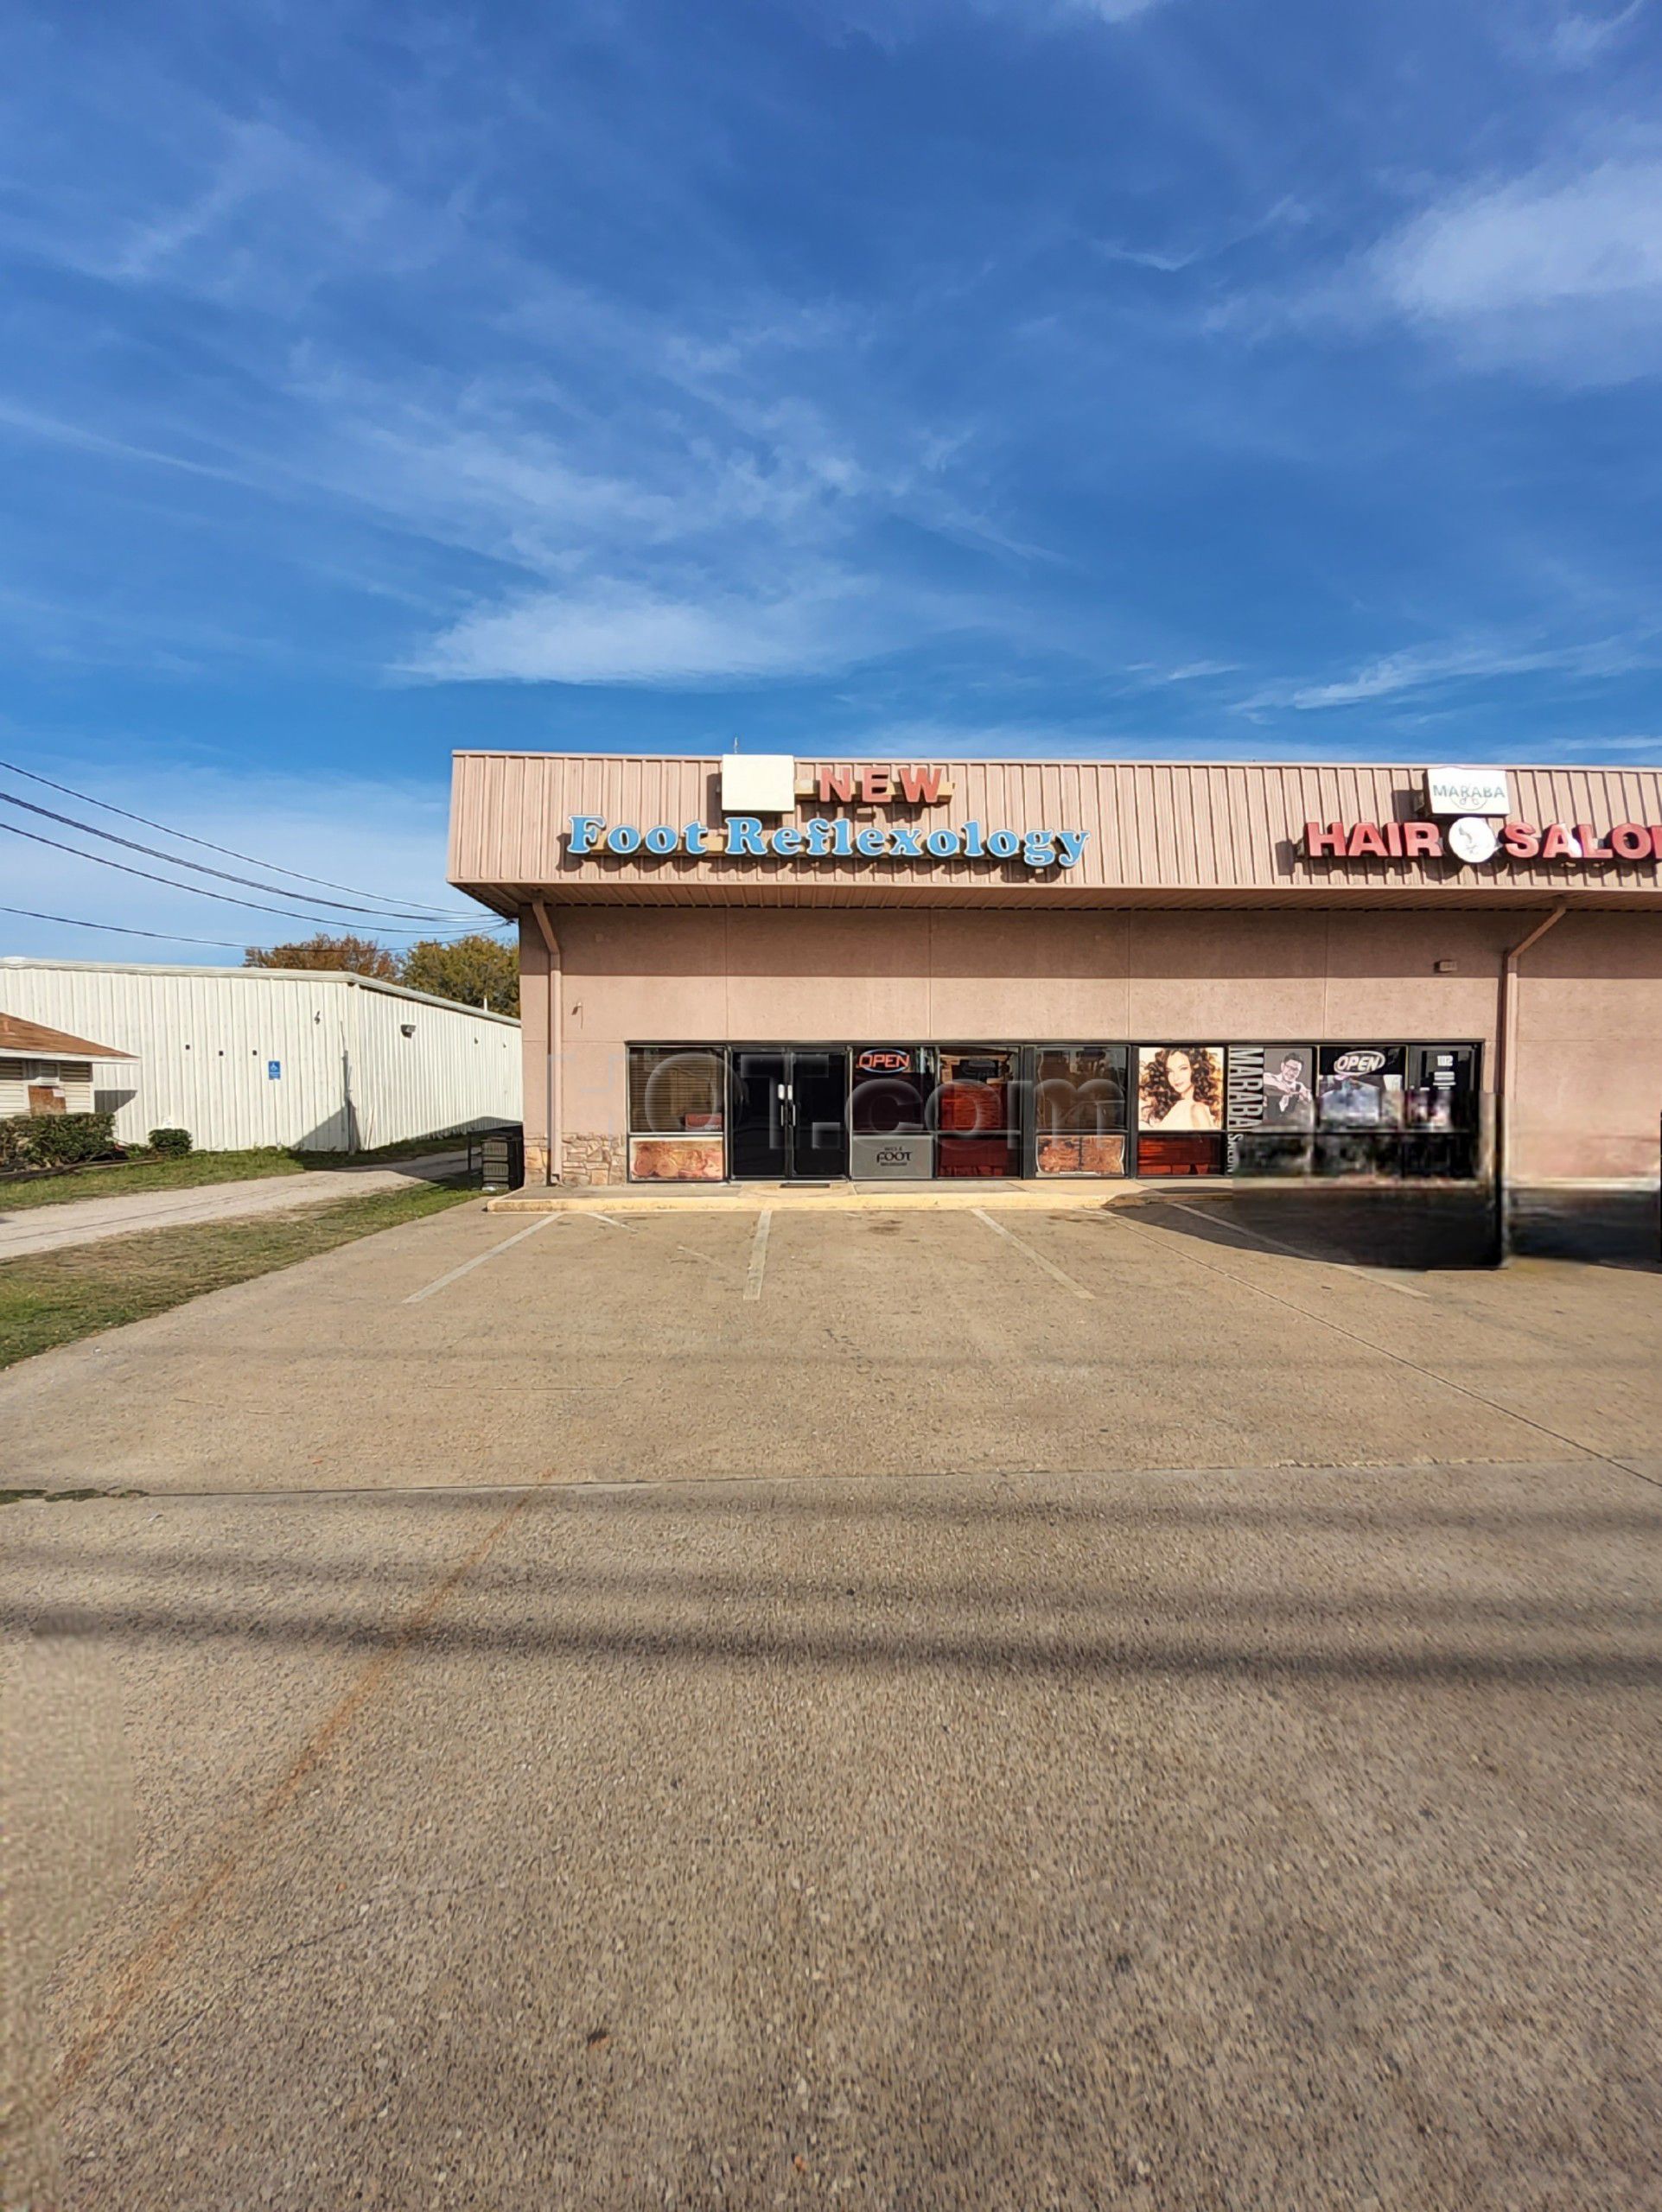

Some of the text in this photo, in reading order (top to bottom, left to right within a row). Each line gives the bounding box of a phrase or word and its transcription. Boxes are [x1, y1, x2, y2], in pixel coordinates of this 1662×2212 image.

[819, 767, 943, 803] NEW
[1433, 785, 1506, 798] MARABA
[567, 814, 1091, 867] Foot Reflexology
[1305, 822, 1662, 859] HAIR SALO
[857, 1053, 910, 1069] OPEN
[1337, 1055, 1380, 1071] OPEN
[1228, 1047, 1264, 1131] MARABA
